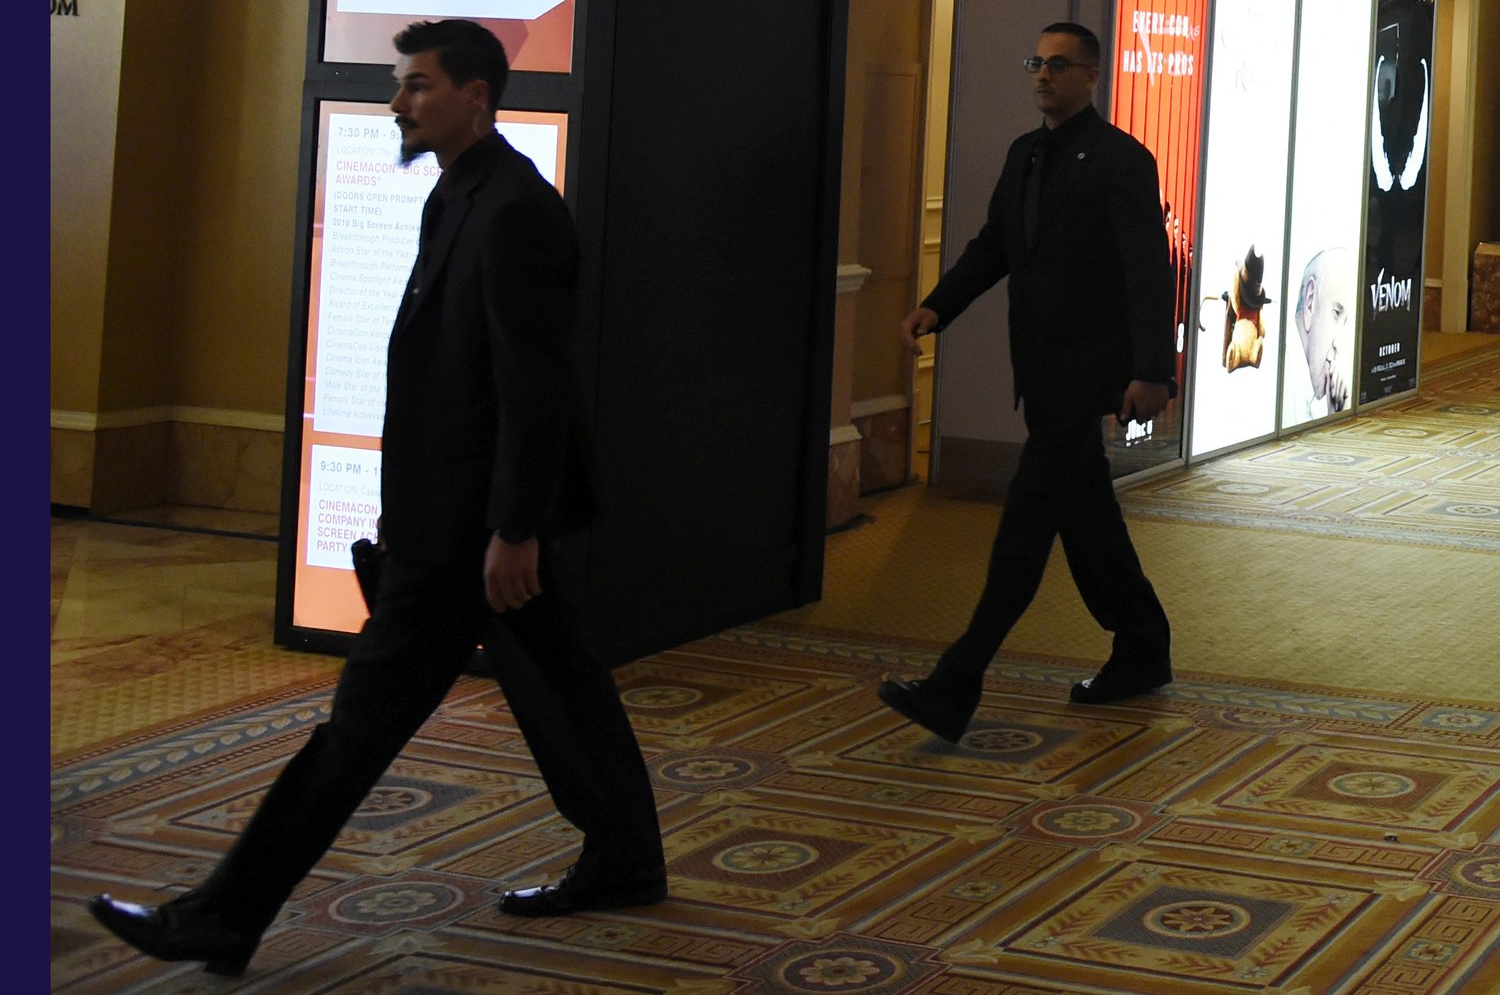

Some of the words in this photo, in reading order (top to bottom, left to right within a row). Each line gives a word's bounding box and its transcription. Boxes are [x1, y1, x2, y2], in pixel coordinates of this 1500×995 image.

[1133, 10, 1164, 36] EVERY
[1123, 50, 1142, 73] HAS
[1168, 54, 1194, 76] PROS
[1370, 267, 1412, 316] VENOM
[319, 500, 378, 515] CINEMACON
[316, 540, 348, 553] PARTY
